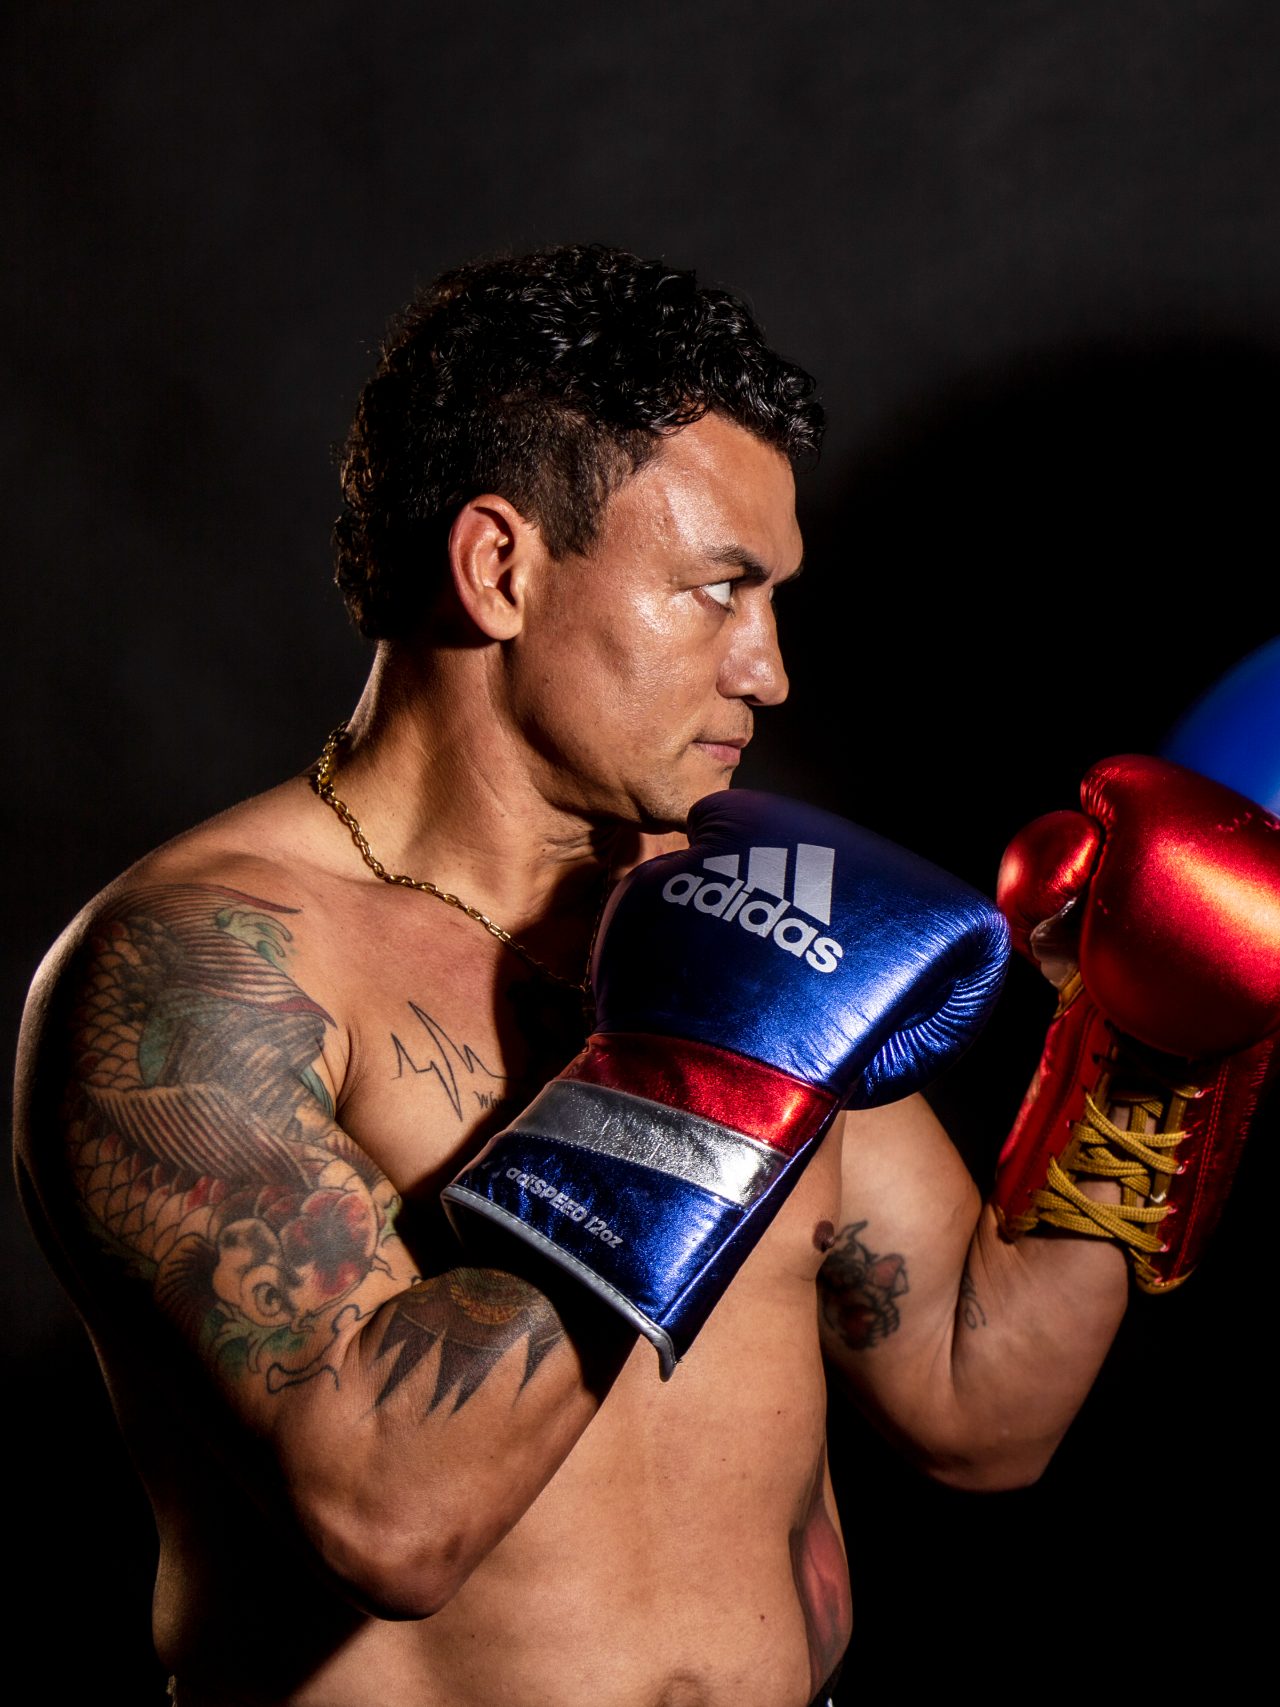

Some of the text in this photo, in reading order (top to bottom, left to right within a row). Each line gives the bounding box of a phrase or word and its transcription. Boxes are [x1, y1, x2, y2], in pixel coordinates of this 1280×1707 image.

[662, 872, 844, 974] adidas
[505, 1167, 624, 1249] adiSPEED 12oz
